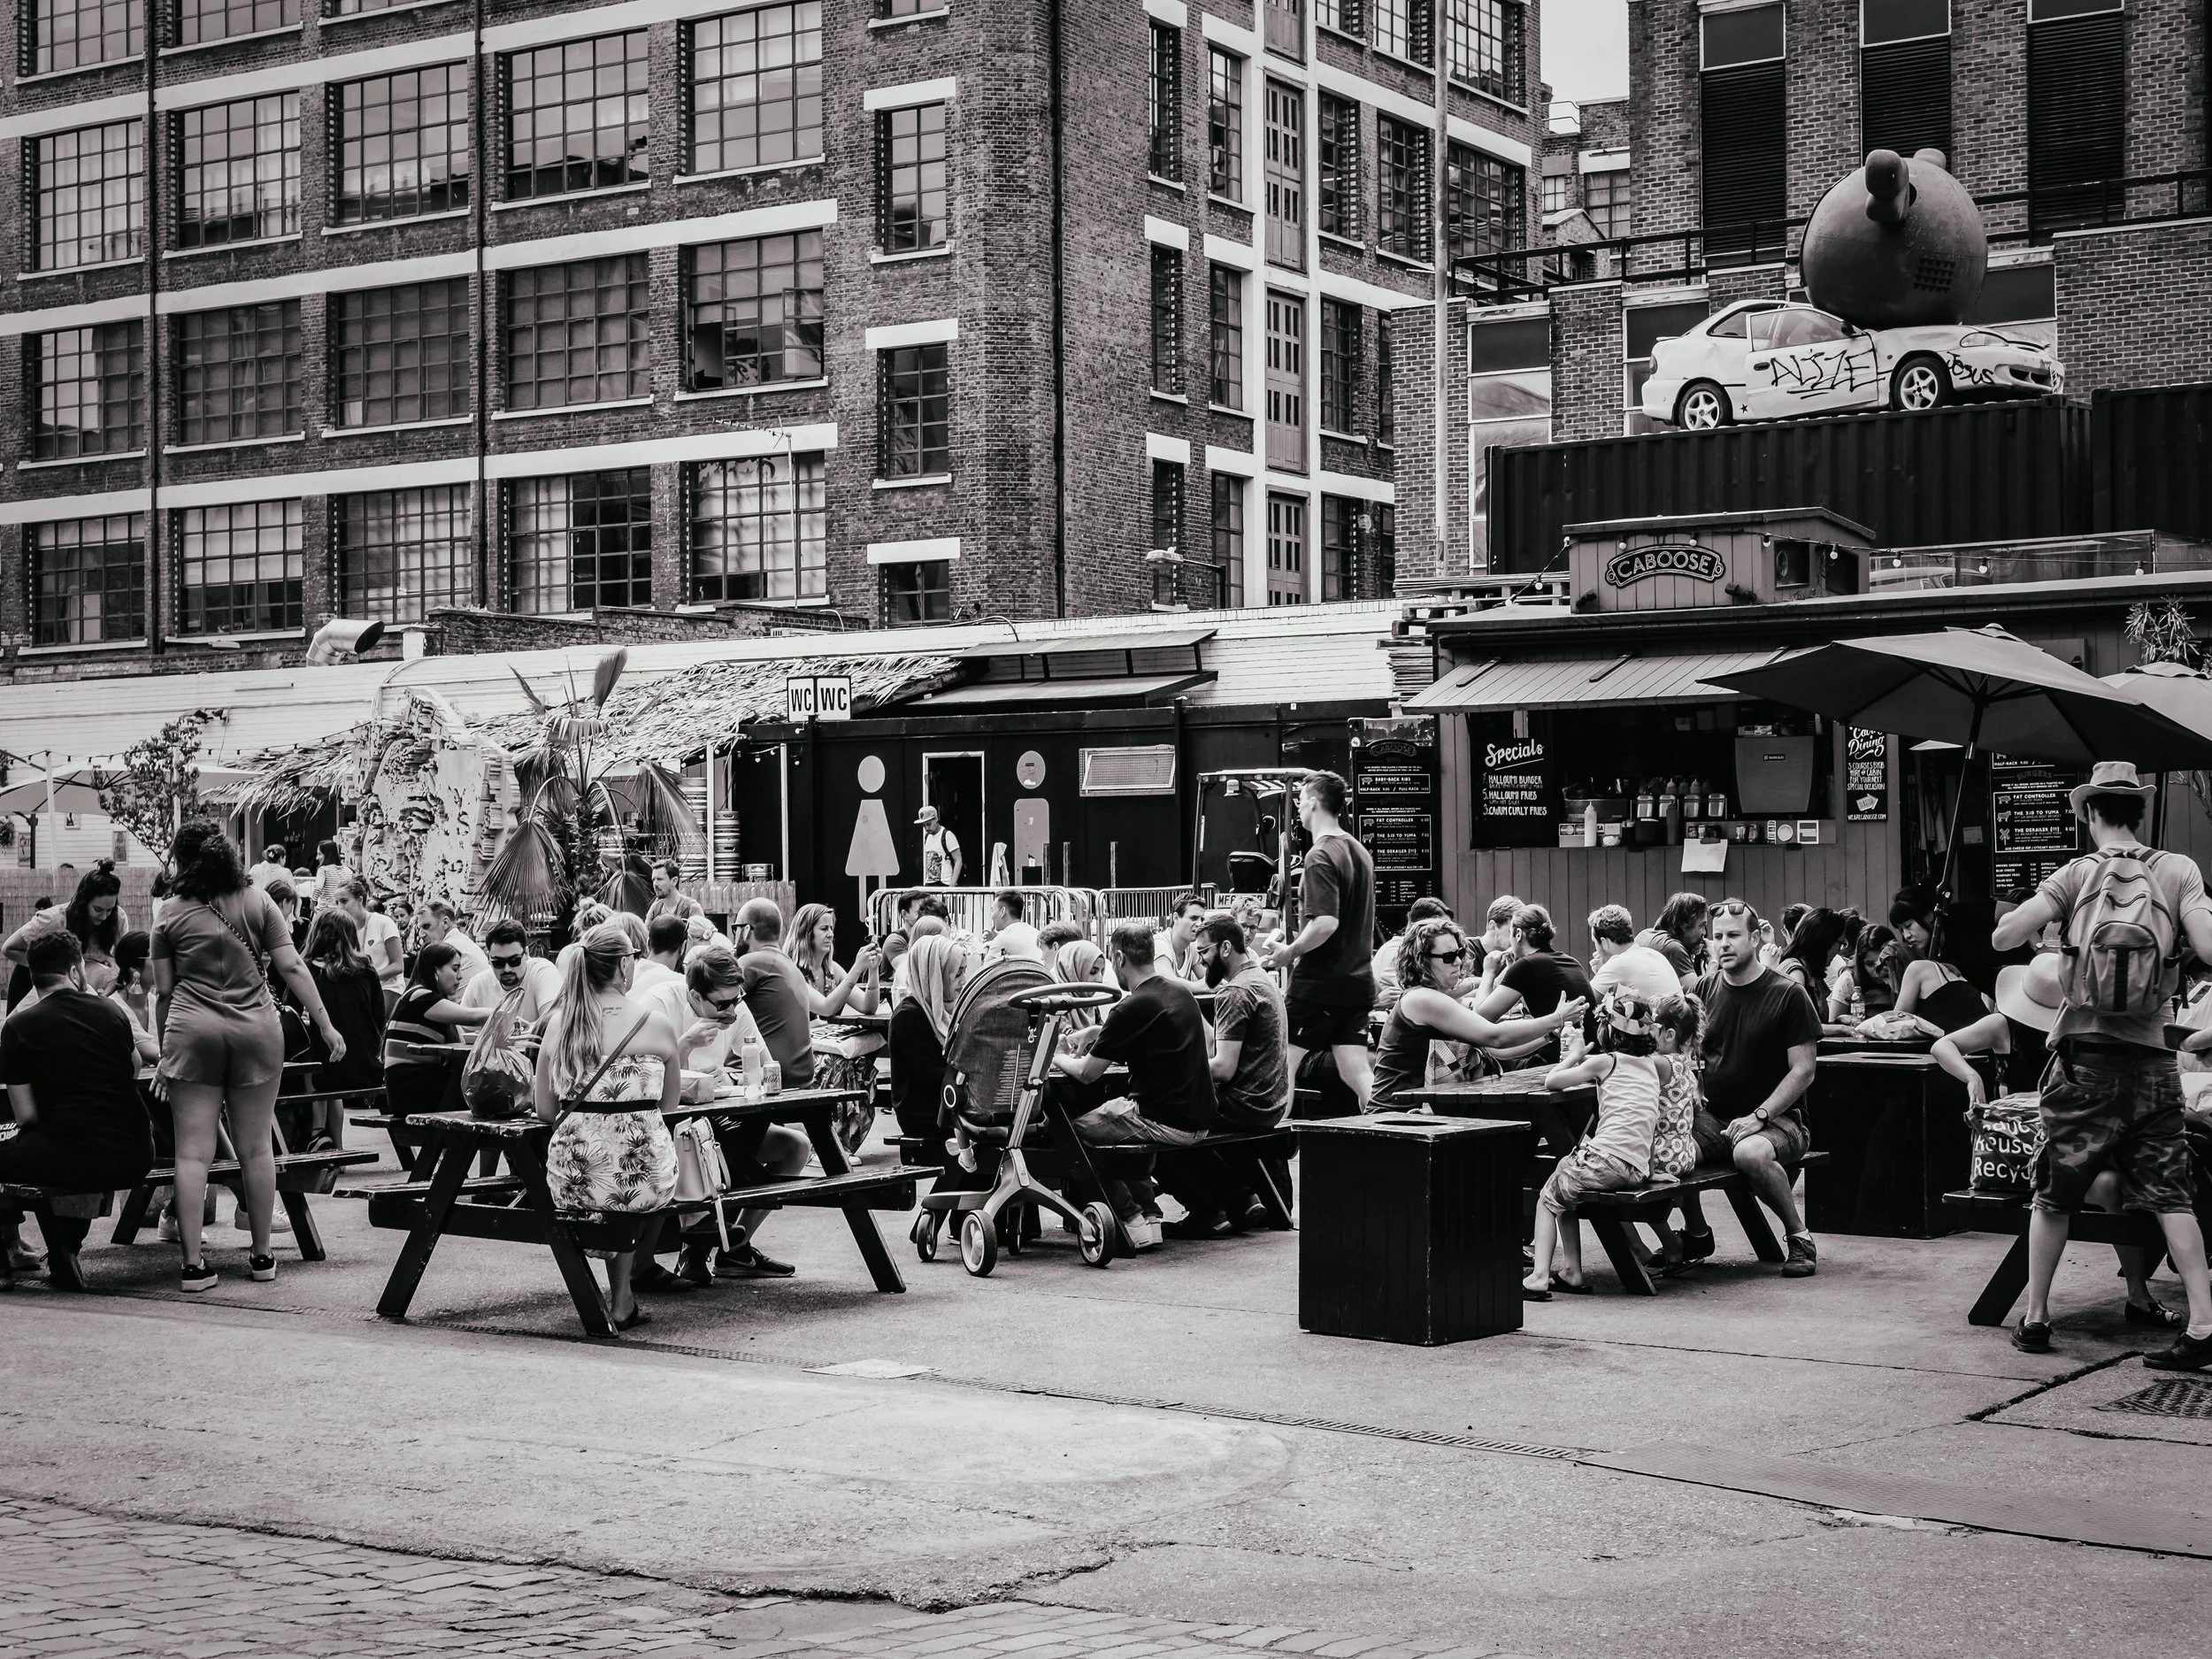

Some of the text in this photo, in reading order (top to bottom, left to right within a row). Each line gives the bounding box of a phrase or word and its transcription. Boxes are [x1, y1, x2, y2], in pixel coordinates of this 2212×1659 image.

[1617, 550, 1711, 578] CABOOSE
[791, 688, 811, 711] WC
[820, 687, 847, 710] WC
[1374, 744, 1413, 754] CABOOSE
[1485, 738, 1544, 767] Specials
[1848, 736, 1885, 757] Dining
[1488, 775, 1517, 784] HALLOUMI
[1519, 775, 1542, 784] BURGER
[1488, 791, 1518, 800] HALLOUMI
[1520, 791, 1537, 800] FRIES
[1508, 806, 1529, 816] CURLY
[1529, 806, 1547, 815] FRIES
